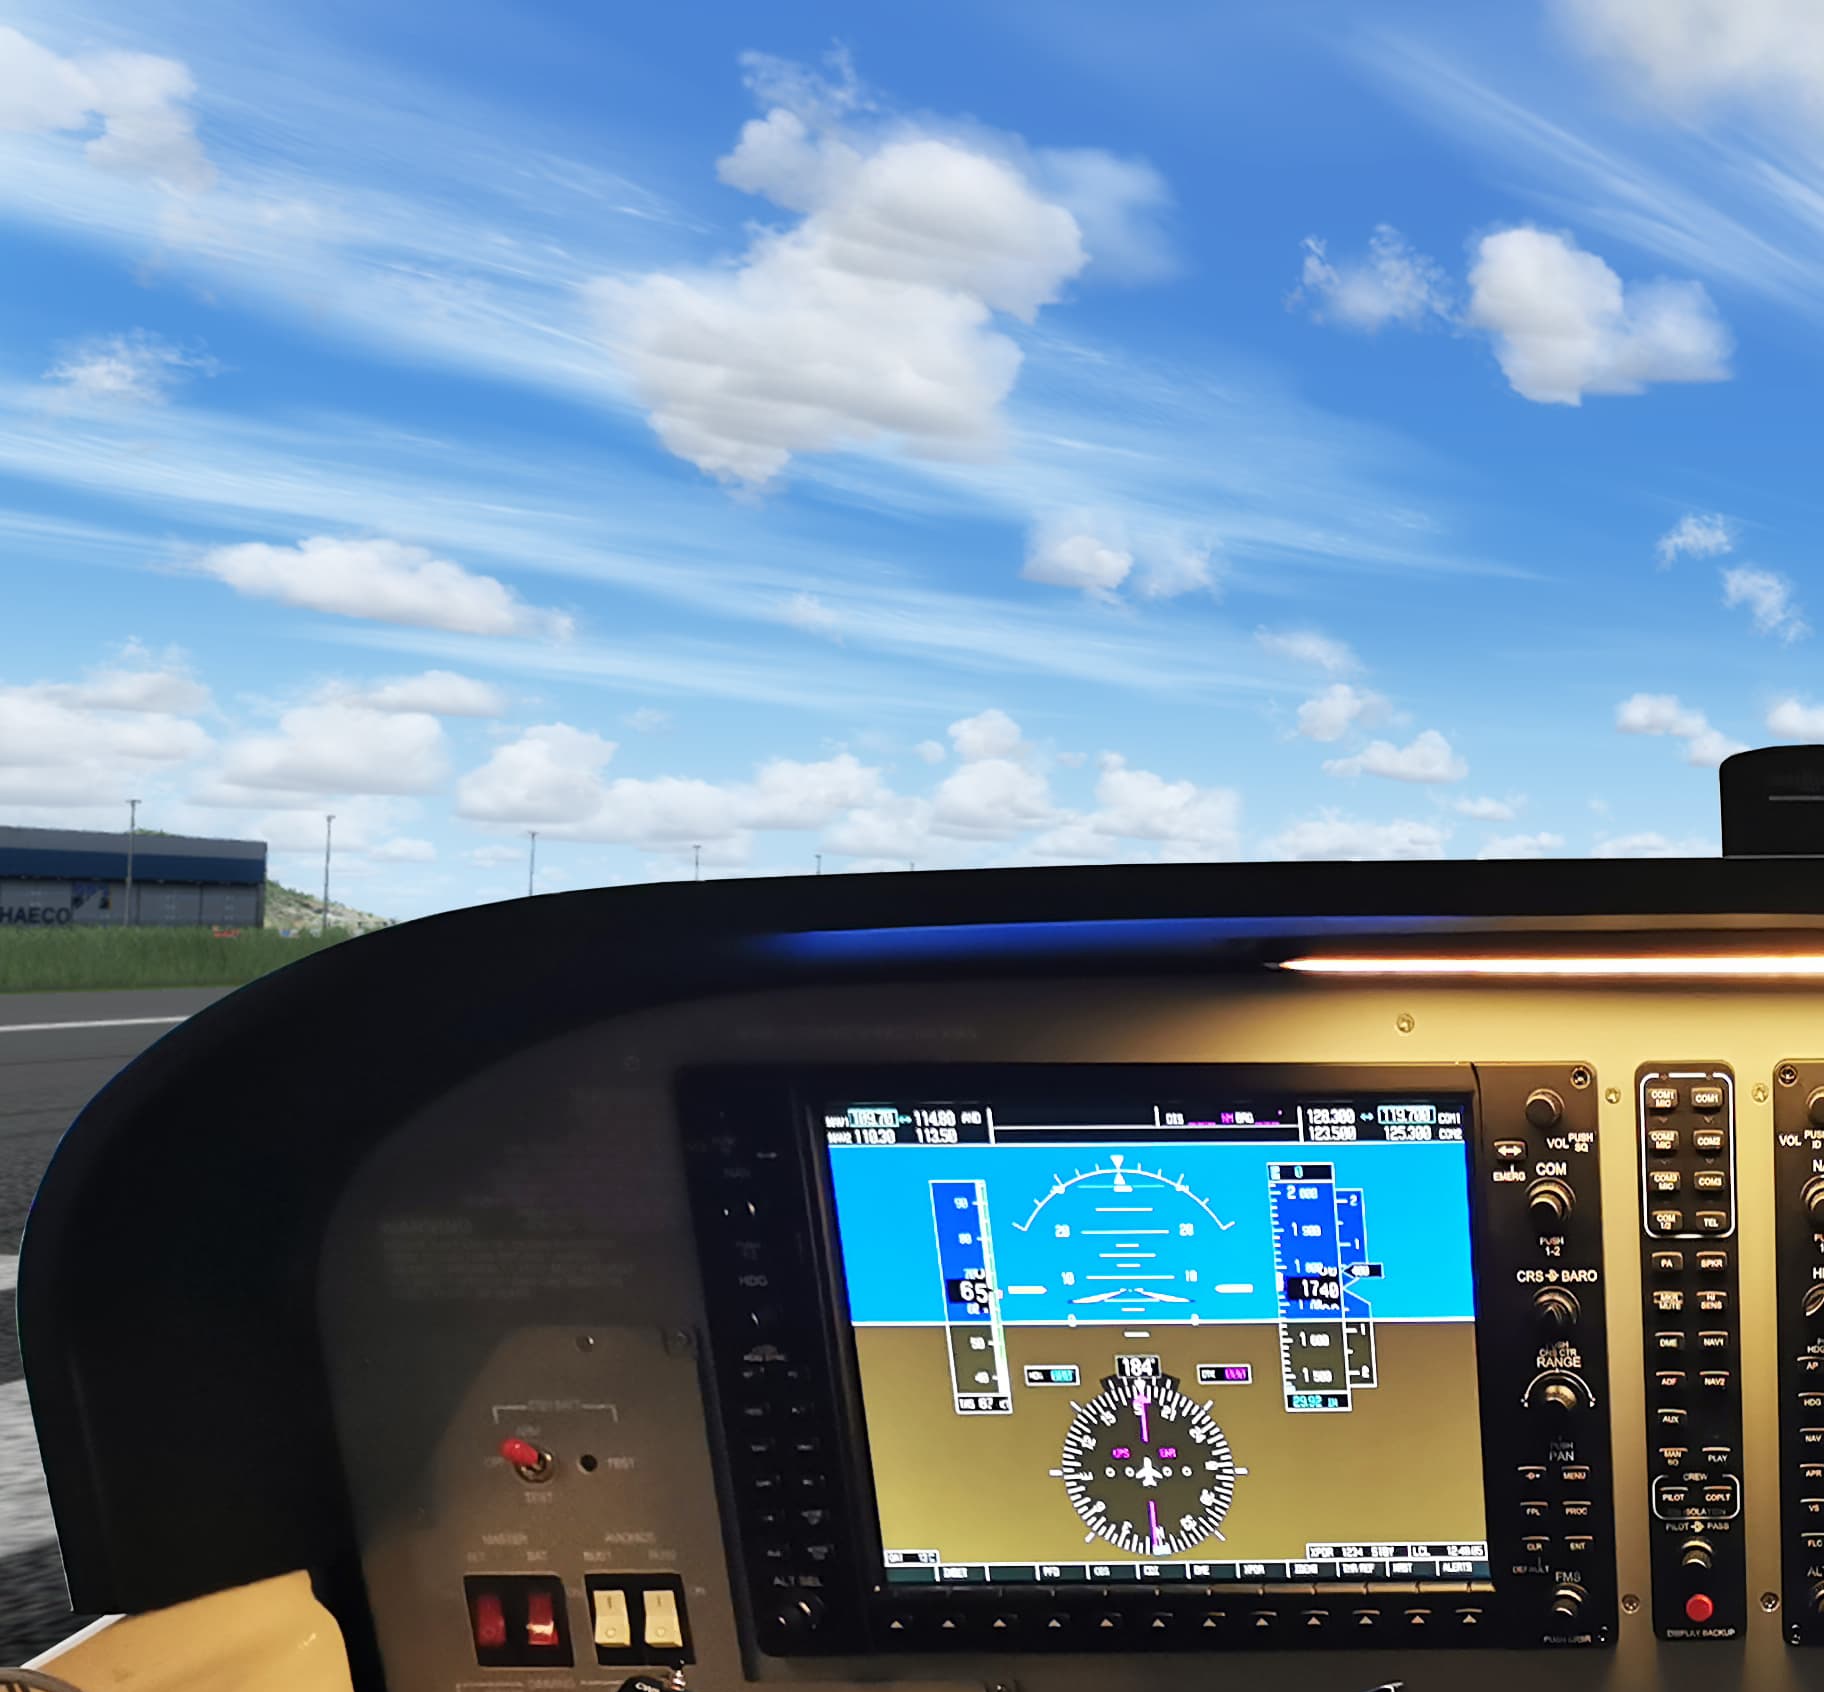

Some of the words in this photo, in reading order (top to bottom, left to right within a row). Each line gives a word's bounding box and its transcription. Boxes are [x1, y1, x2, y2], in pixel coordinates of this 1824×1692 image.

[0, 907, 71, 924] HAECO
[1651, 1091, 1674, 1099] COM1
[1695, 1094, 1718, 1103] COM1
[1656, 1099, 1672, 1108] MIC
[1568, 1133, 1593, 1143] PUSH
[1697, 1137, 1720, 1146] COM2
[1779, 1135, 1801, 1146] VOL
[1547, 1138, 1569, 1149] VOL
[1812, 1140, 1822, 1149] ID
[1536, 1163, 1567, 1176] COM
[1493, 1172, 1525, 1182] EMERG
[1698, 1178, 1722, 1187] COM3
[1657, 1214, 1675, 1223] COM
[1703, 1218, 1718, 1227] TEL
[1545, 1247, 1560, 1256] 1-2
[1661, 1259, 1672, 1268] PA
[1517, 1270, 1543, 1282] CRS
[1562, 1270, 1597, 1282] BARO
[960, 1282, 988, 1302] 65
[1302, 1280, 1340, 1298] 1740
[1660, 1338, 1678, 1347] DME
[1537, 1356, 1581, 1368] RANGE
[1806, 1361, 1819, 1370] AP
[1661, 1378, 1678, 1386] ADF
[1804, 1398, 1821, 1407] HDG
[1662, 1416, 1679, 1424] AUX
[1549, 1452, 1574, 1461] PAN
[1708, 1454, 1728, 1462] PLAY
[1563, 1472, 1586, 1480] MENU
[1662, 1493, 1684, 1502] PILOT
[1705, 1493, 1730, 1502] COPLT
[1527, 1508, 1540, 1516] FPL
[1809, 1504, 1820, 1512] VS
[1666, 1522, 1688, 1531] PILOT
[1808, 1539, 1822, 1547] FLC
[1555, 1571, 1581, 1582] FMS
[1702, 1628, 1735, 1637] BACKUP
